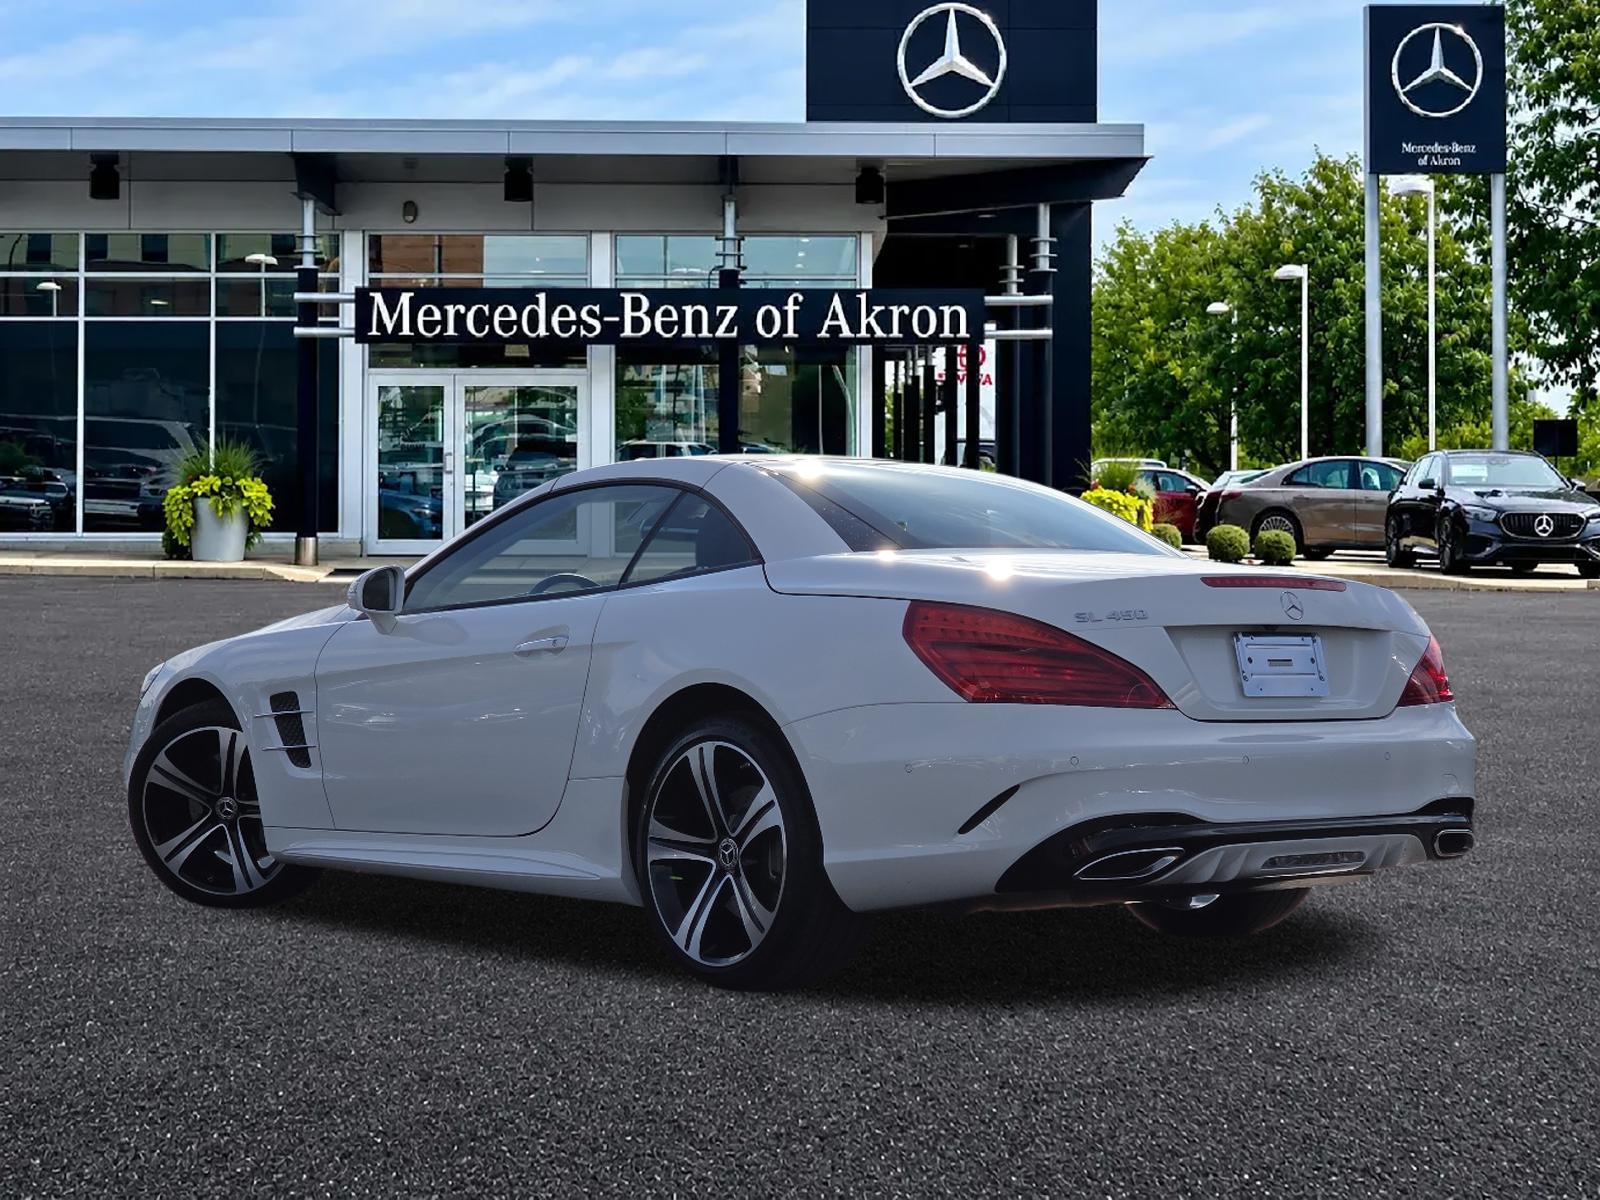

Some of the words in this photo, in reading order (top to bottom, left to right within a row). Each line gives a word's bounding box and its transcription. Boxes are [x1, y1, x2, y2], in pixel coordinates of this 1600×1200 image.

[1401, 142, 1477, 153] Mercedes-Benz
[1417, 154, 1429, 165] of
[1430, 154, 1461, 165] Akron
[367, 291, 738, 338] Mercedes-Benz
[755, 292, 804, 338] of
[816, 292, 970, 338] Akron
[1074, 611, 1103, 623] SL
[1105, 609, 1149, 621] 450
